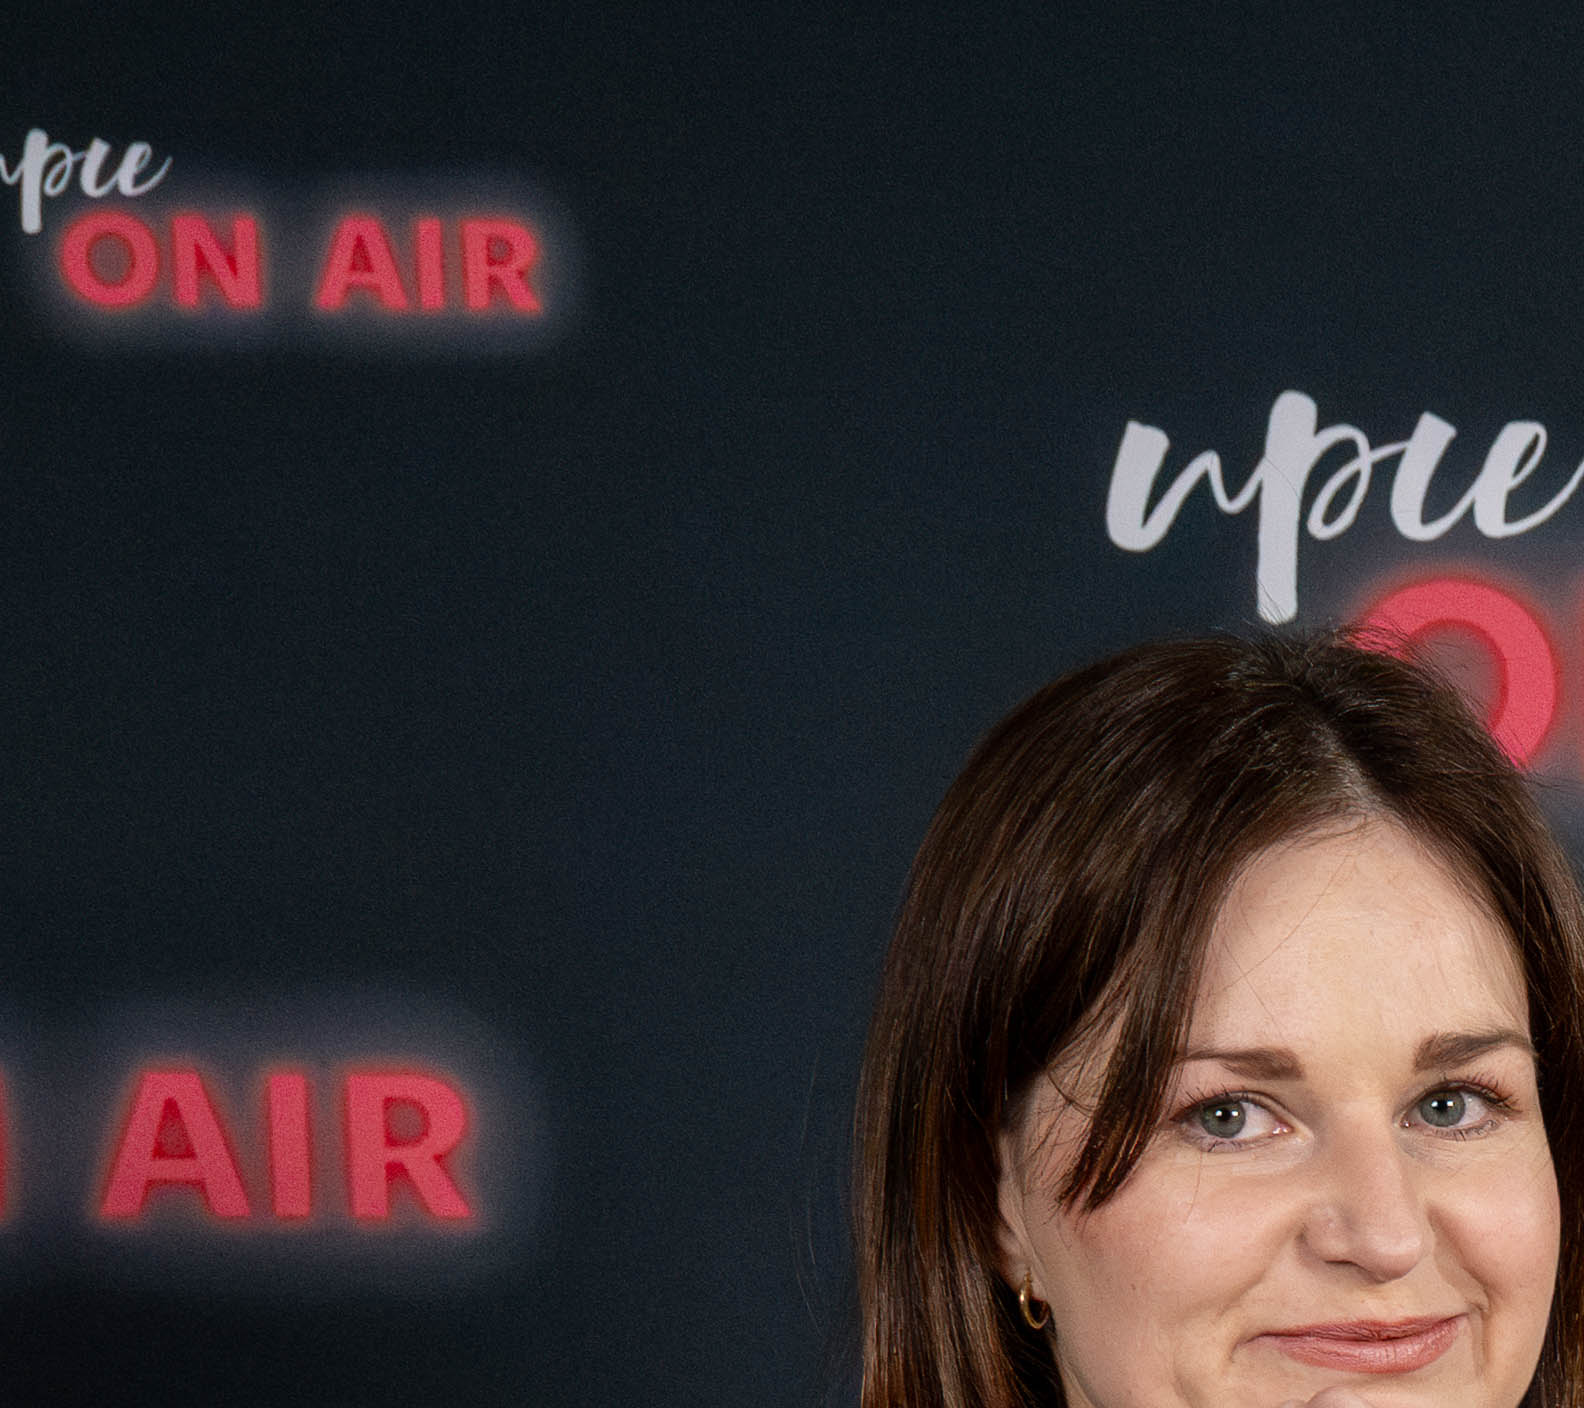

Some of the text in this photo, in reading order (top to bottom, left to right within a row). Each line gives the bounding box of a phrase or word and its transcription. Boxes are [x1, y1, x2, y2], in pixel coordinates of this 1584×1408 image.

[61, 212, 539, 311] ON AIR
[101, 1069, 472, 1221] AIR
